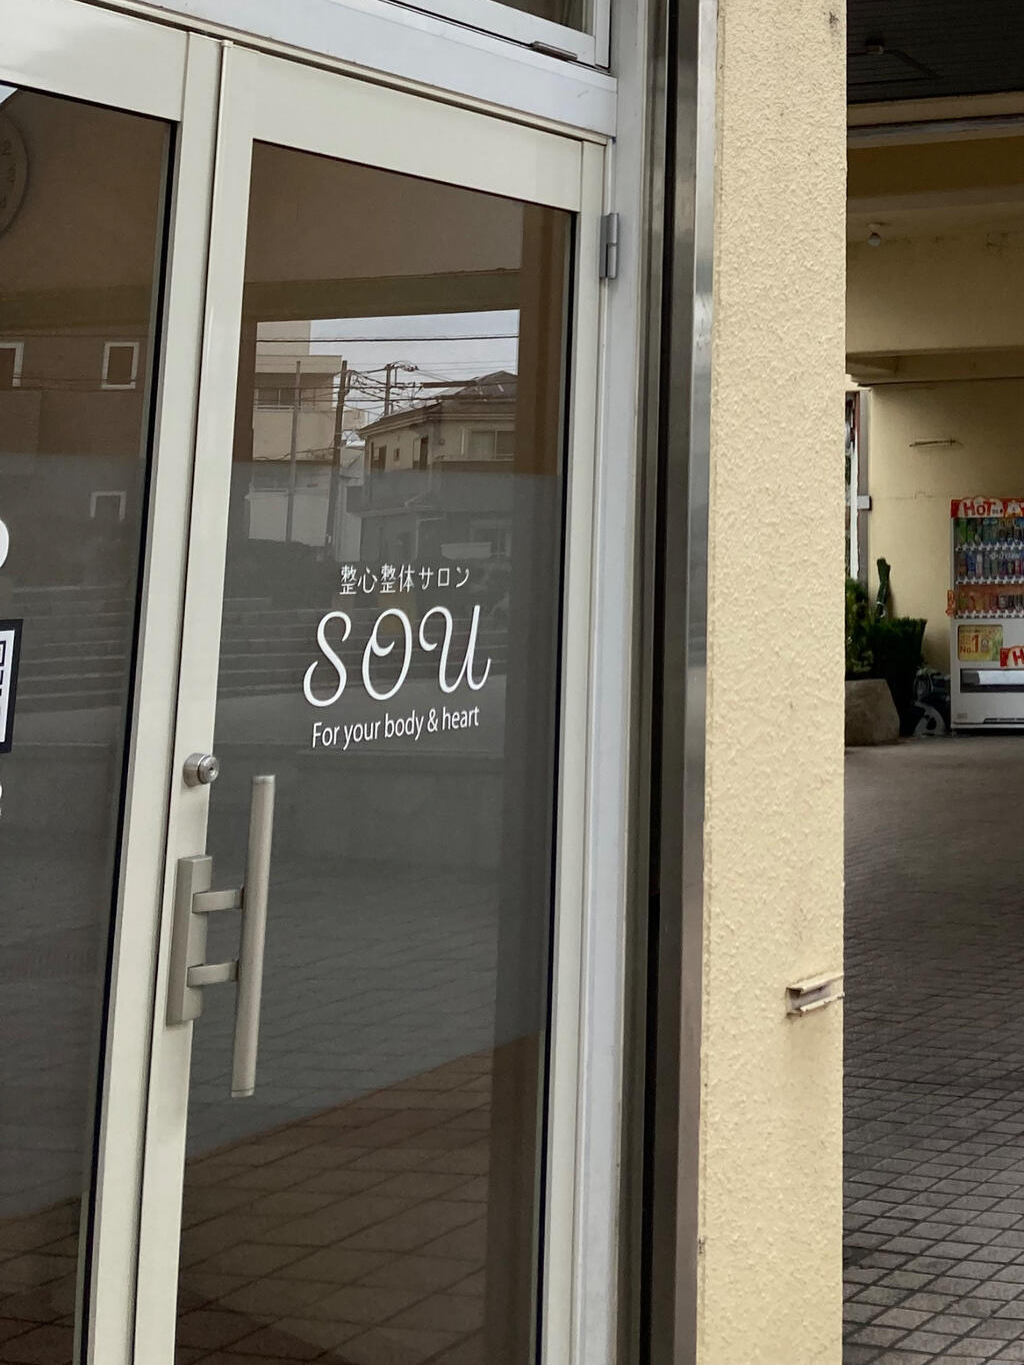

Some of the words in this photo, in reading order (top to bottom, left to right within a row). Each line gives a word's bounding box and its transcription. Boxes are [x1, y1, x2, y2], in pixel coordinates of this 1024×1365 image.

[339, 563, 470, 595] 整心整体サロン
[312, 722, 340, 748] For
[343, 720, 381, 751] your
[384, 709, 424, 741] body
[427, 709, 438, 732] &
[442, 706, 479, 729] heart
